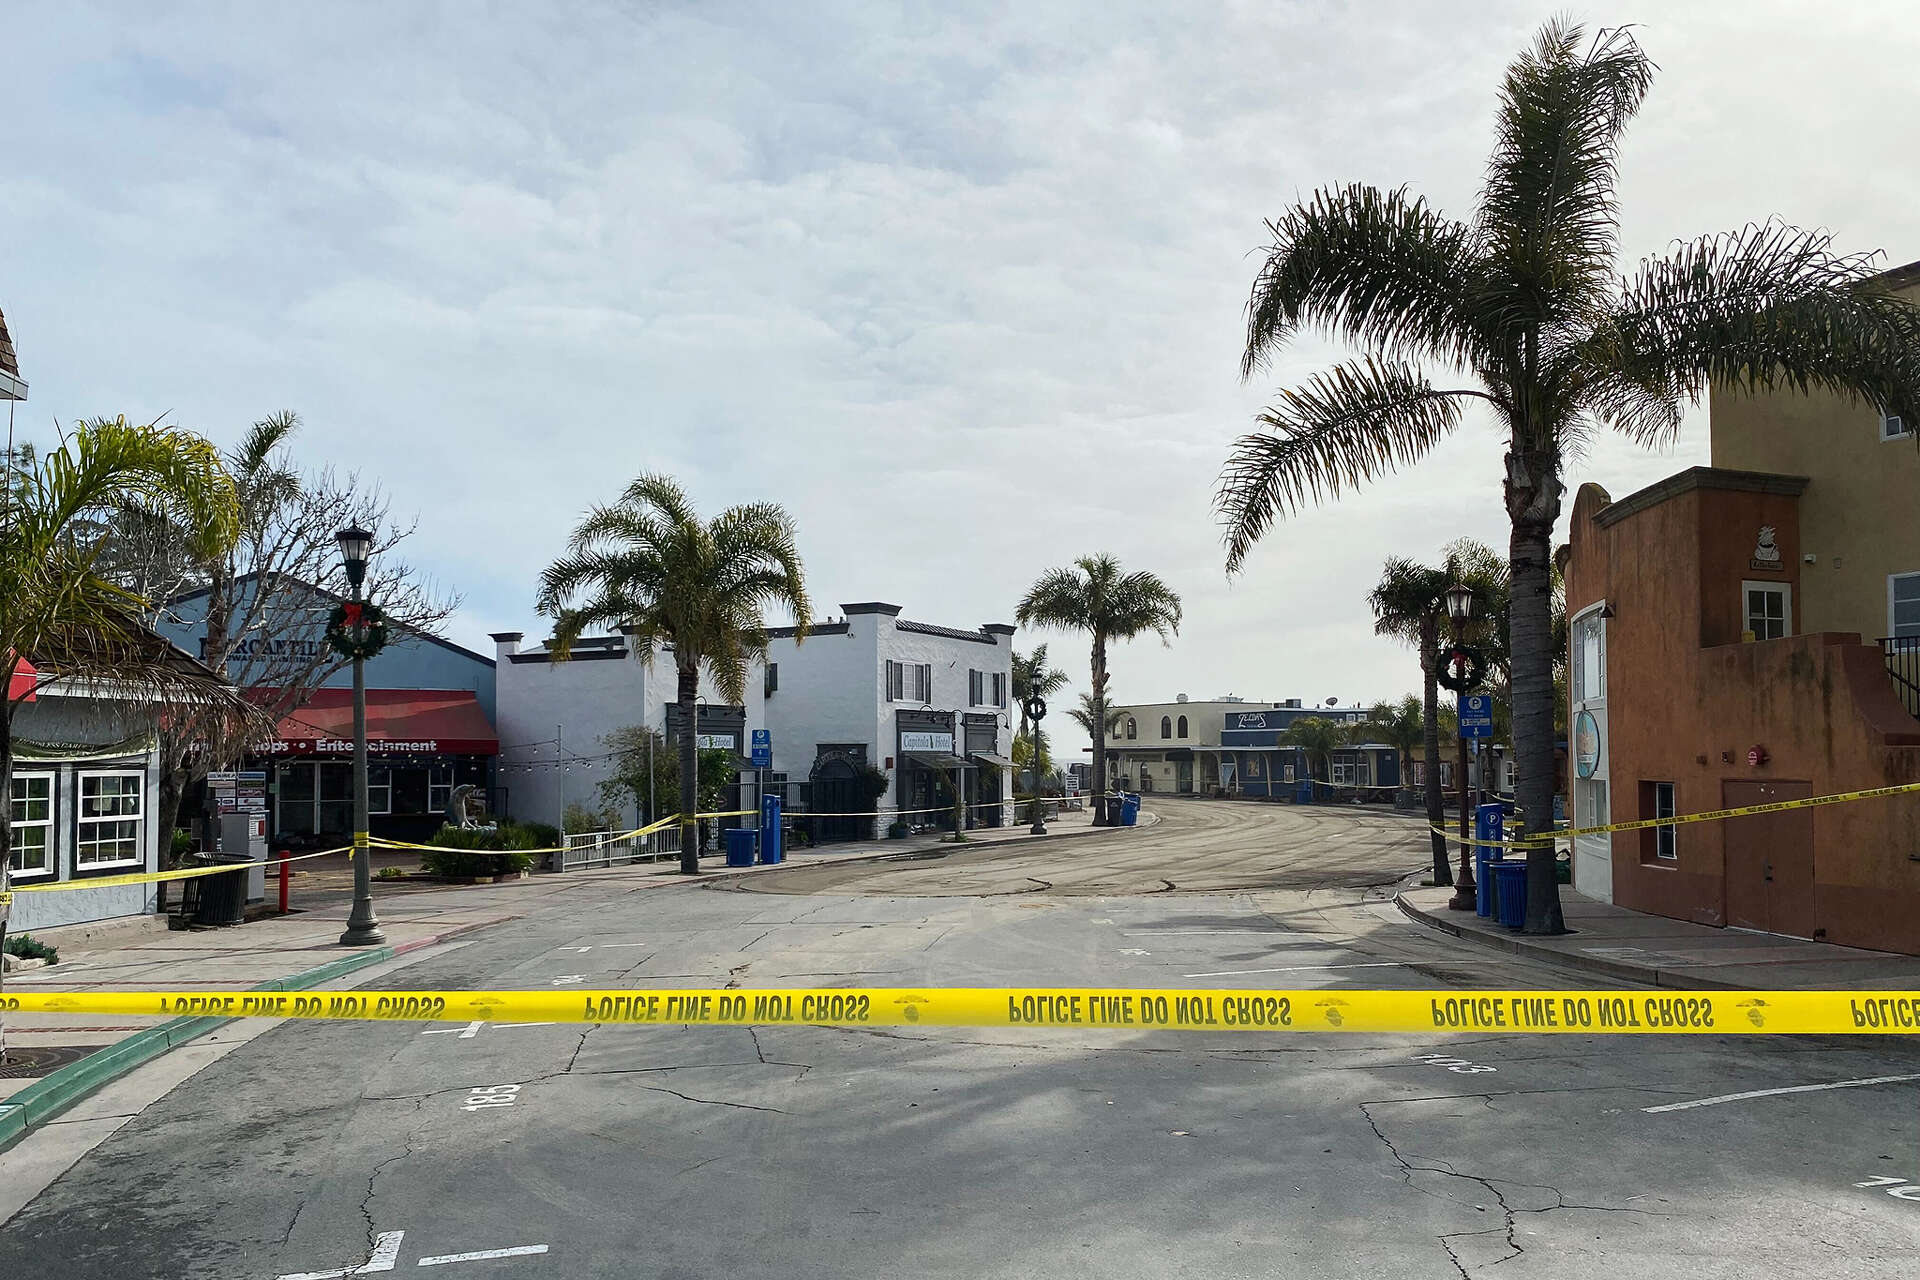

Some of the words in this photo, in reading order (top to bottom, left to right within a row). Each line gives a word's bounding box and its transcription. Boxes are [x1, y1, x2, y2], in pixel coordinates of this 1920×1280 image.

[316, 739, 437, 752] Enteainment
[903, 735, 929, 749] Capitola
[935, 735, 951, 749] Hotel
[460, 1084, 521, 1112] 185
